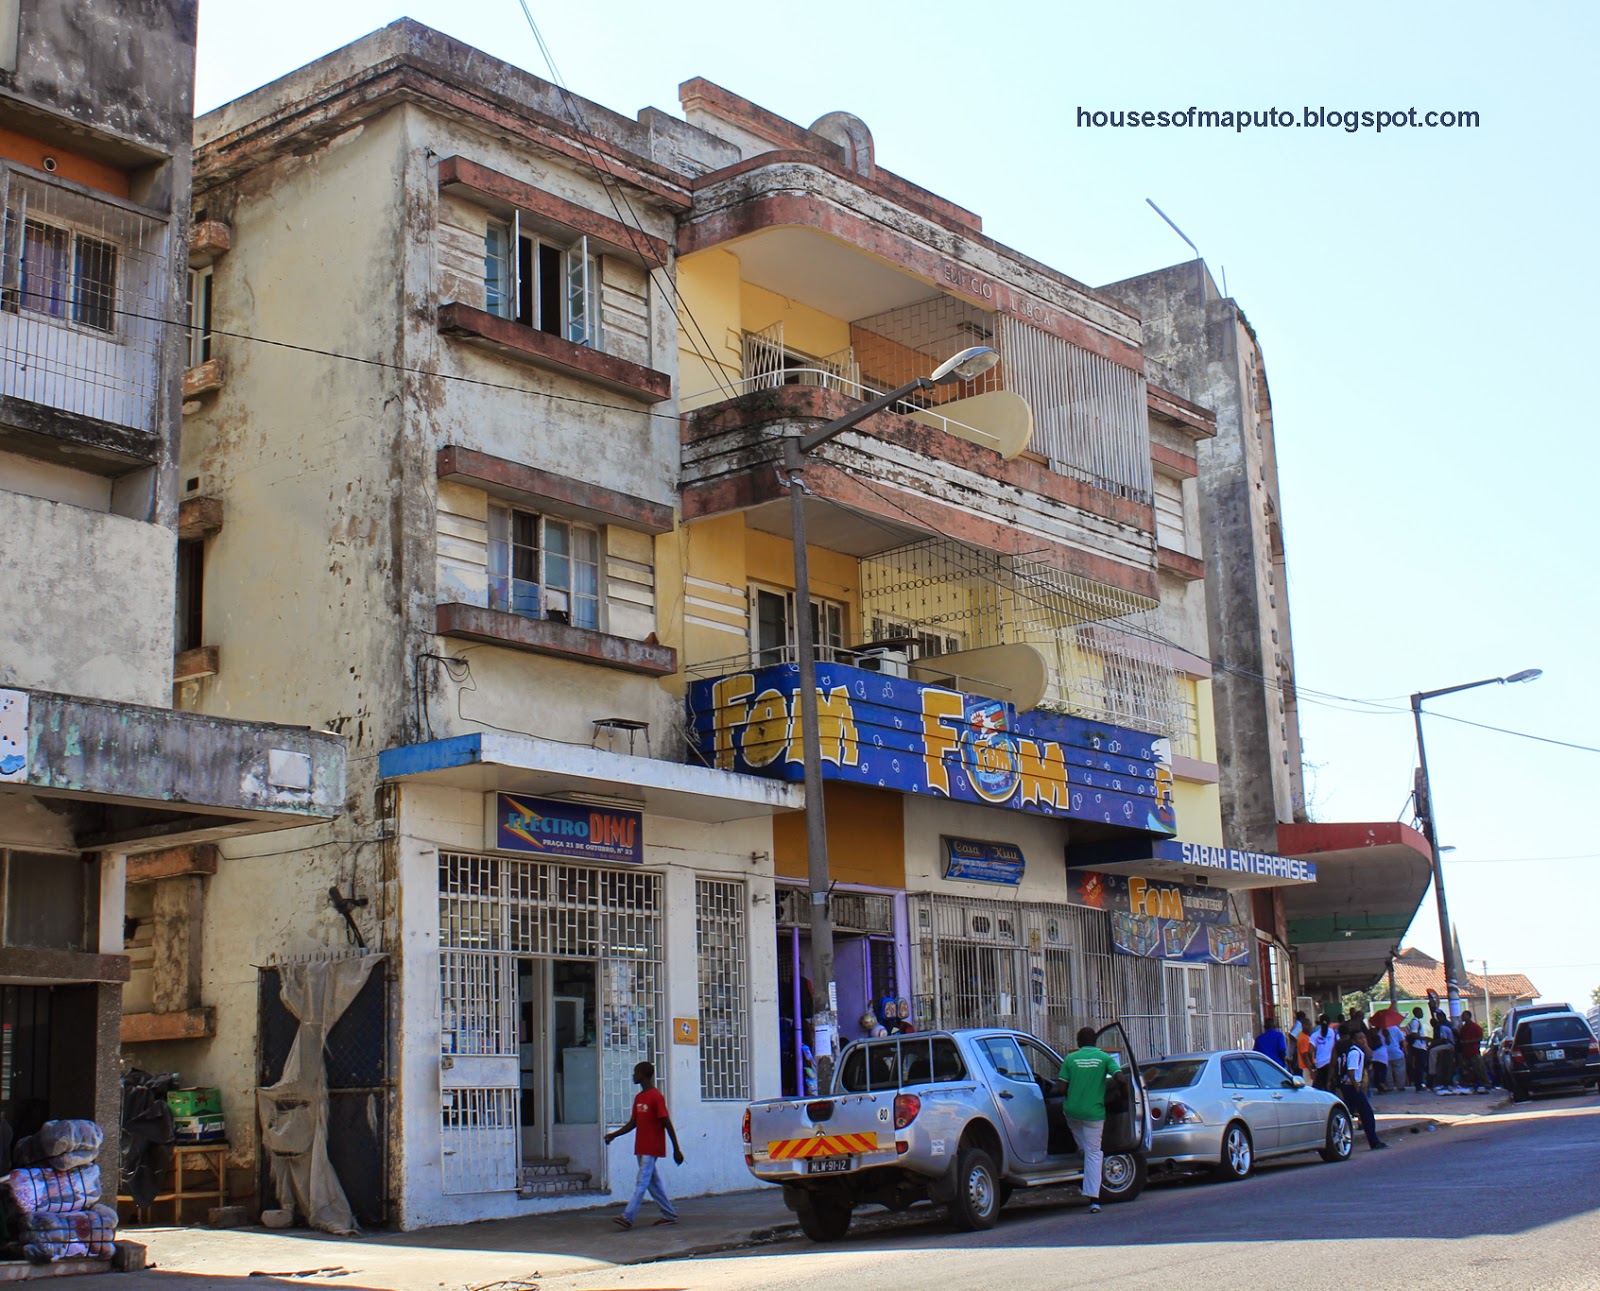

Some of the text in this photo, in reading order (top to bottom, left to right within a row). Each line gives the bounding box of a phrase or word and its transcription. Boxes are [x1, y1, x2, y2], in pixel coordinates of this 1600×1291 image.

[712, 674, 859, 772] FOM
[920, 687, 1070, 809] FOM
[508, 812, 589, 838] ELECTRO
[543, 839, 564, 848] PRAÇA
[566, 841, 574, 849] 21
[954, 840, 980, 855] Casa
[1182, 842, 1228, 870] SABAH
[1230, 849, 1308, 881] ENTERPRISE
[1128, 877, 1184, 921] FOM
[879, 1108, 888, 1121] 80
